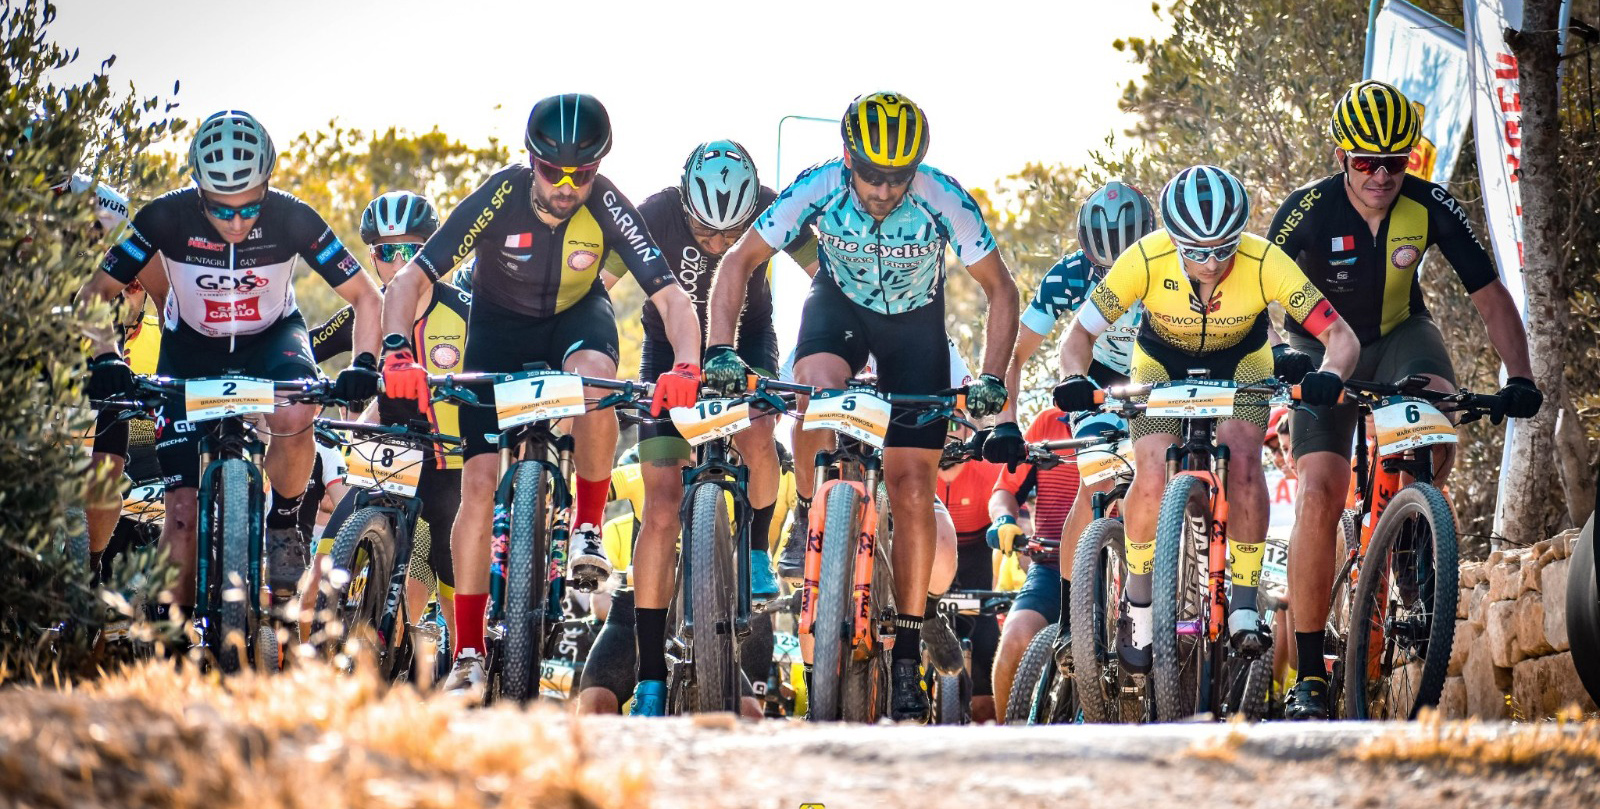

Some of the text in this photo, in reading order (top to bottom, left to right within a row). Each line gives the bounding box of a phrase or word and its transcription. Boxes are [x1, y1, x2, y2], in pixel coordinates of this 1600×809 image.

[1299, 188, 1322, 211] SFC
[453, 207, 494, 265] AGONES
[491, 180, 513, 209] SFC
[602, 190, 657, 263] GARMIN
[312, 308, 350, 348] AGONES
[222, 381, 237, 396] 2
[530, 379, 545, 399] 7
[1186, 388, 1198, 398] 1
[696, 401, 723, 419] 16
[841, 395, 857, 411] 5
[1405, 404, 1420, 424] 6
[381, 447, 395, 468] 8
